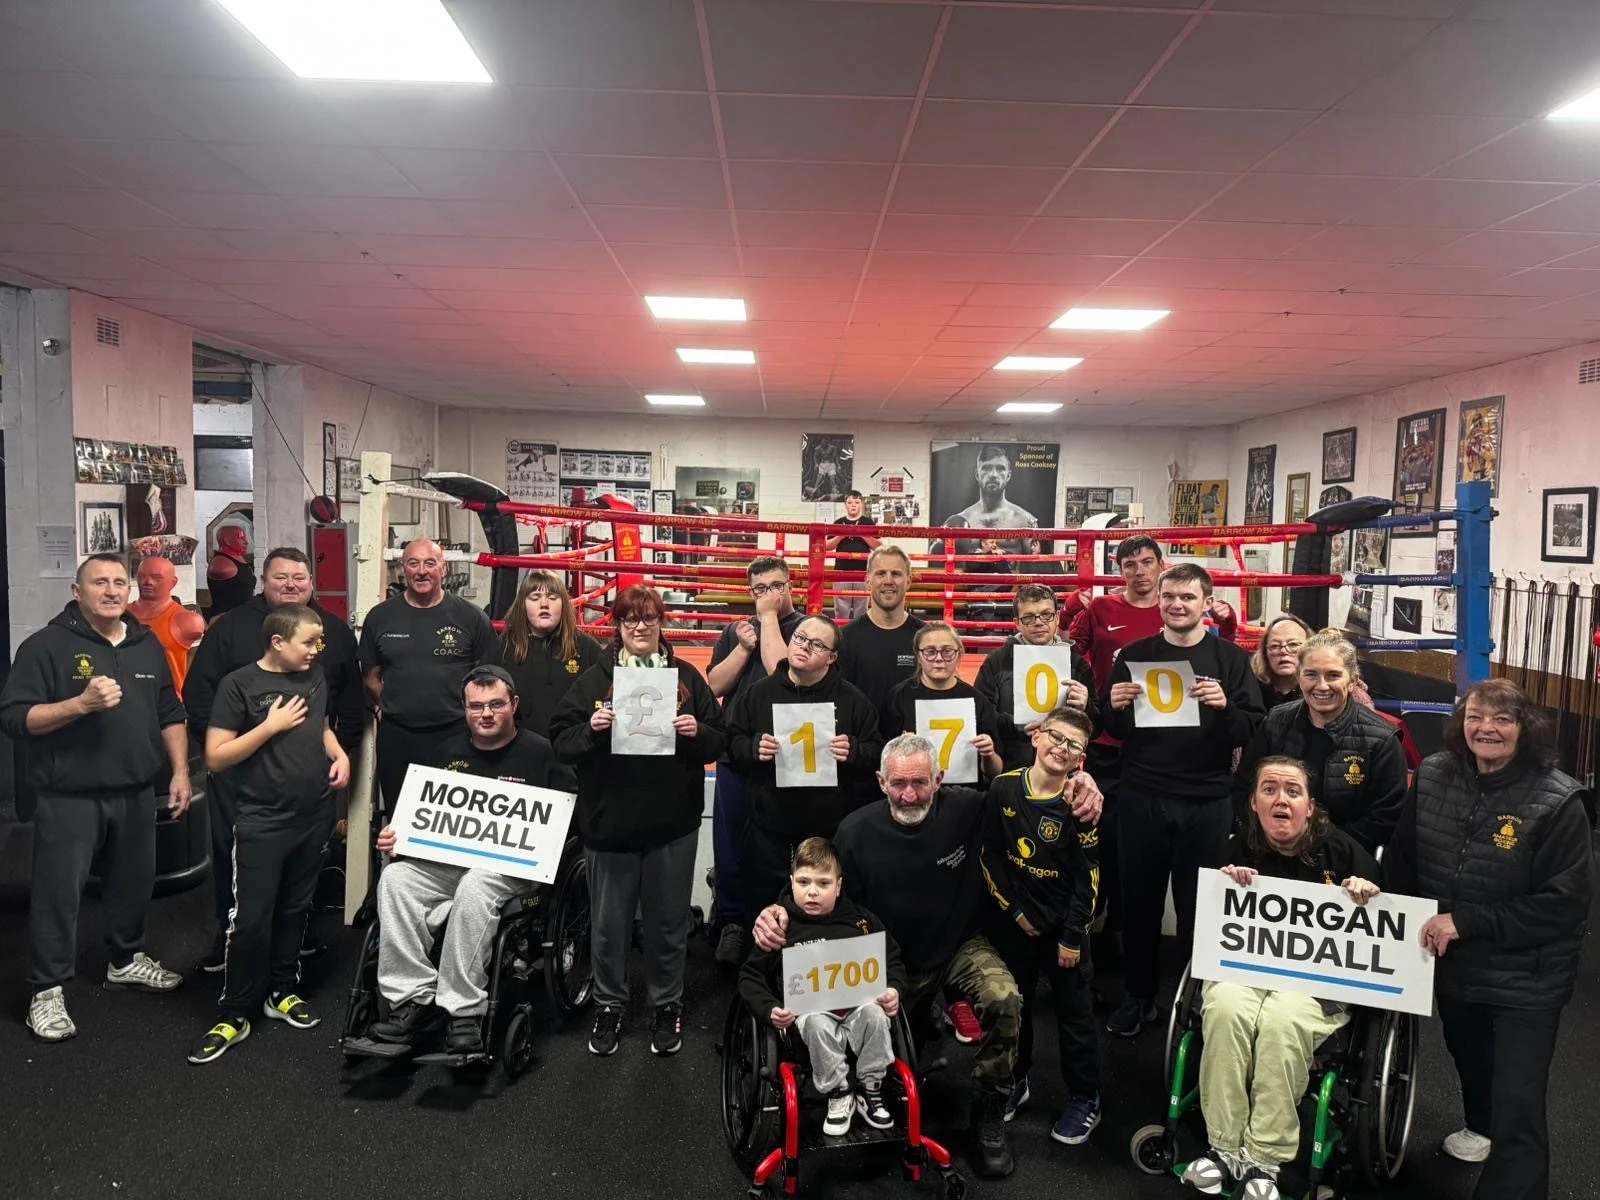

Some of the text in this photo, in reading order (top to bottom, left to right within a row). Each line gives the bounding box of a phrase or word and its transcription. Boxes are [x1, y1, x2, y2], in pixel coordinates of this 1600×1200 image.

[1019, 453, 1045, 461] Sponsor
[1030, 461, 1057, 470] Cooksey
[1176, 483, 1203, 495] FLOAT
[1175, 495, 1194, 506] LIKE
[540, 507, 606, 519] BARROW ABC
[1173, 513, 1199, 525] STING
[655, 515, 718, 526] BARROW ABC
[767, 522, 809, 533] BARROW
[1213, 526, 1277, 536] BARROW ABC
[433, 648, 464, 656] COACH
[1026, 663, 1059, 713] 0
[1145, 669, 1184, 713] 0
[790, 721, 816, 773] 1
[929, 718, 964, 770] 7
[419, 780, 553, 825] MORGAN
[411, 807, 536, 851] SINDALL
[1223, 888, 1406, 941] MORGAN
[1219, 922, 1395, 975] SINDALL
[788, 957, 880, 996] £1700
